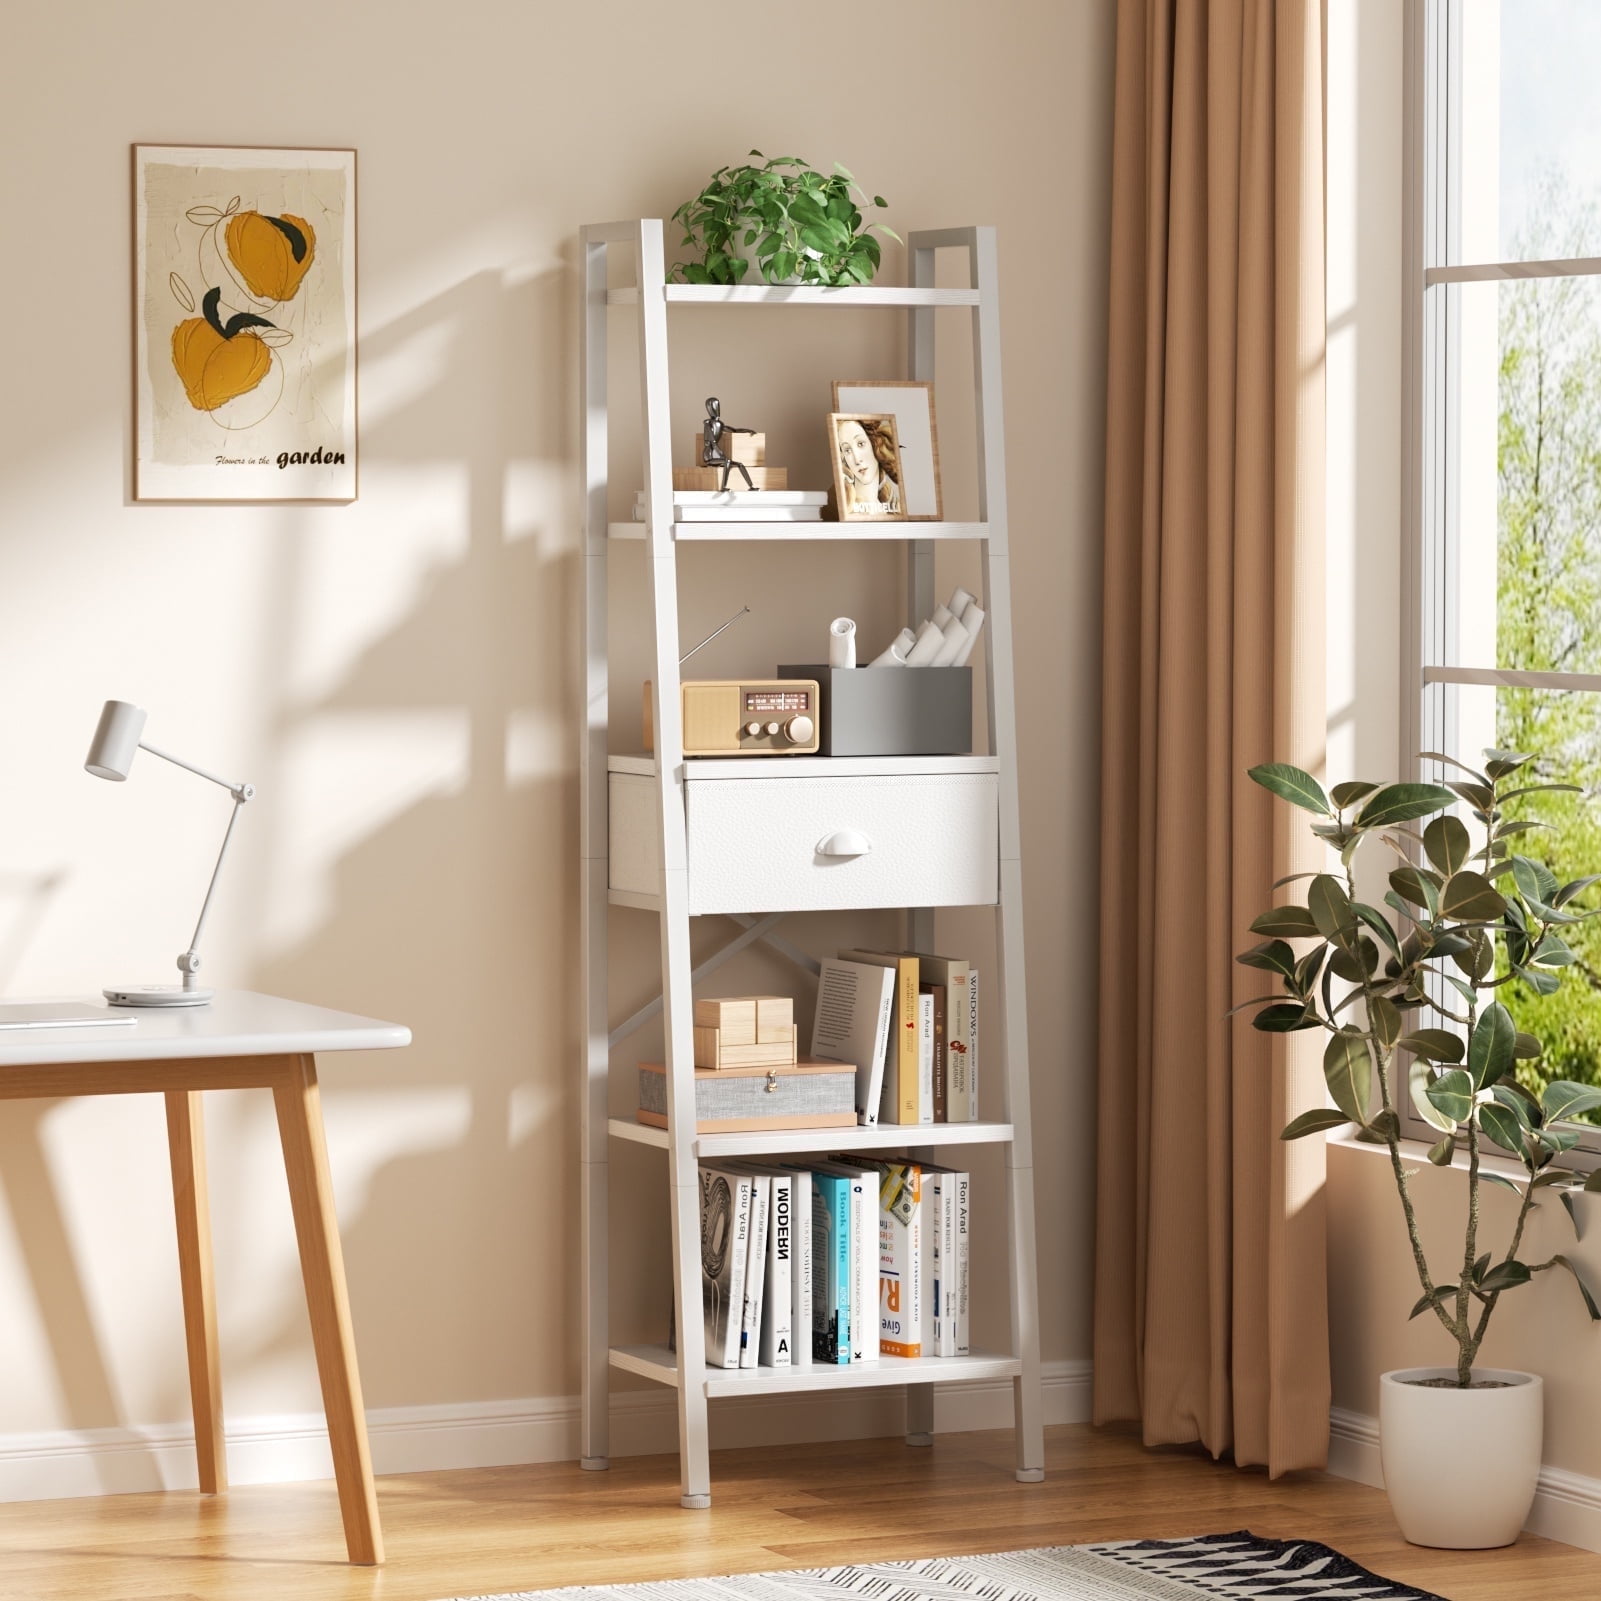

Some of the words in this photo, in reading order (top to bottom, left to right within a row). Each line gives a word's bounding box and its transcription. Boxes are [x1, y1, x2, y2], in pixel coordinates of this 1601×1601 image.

[215, 456, 245, 466] Flowers
[258, 456, 270, 465] the
[276, 446, 345, 469] garden
[882, 1318, 900, 1334] Give
